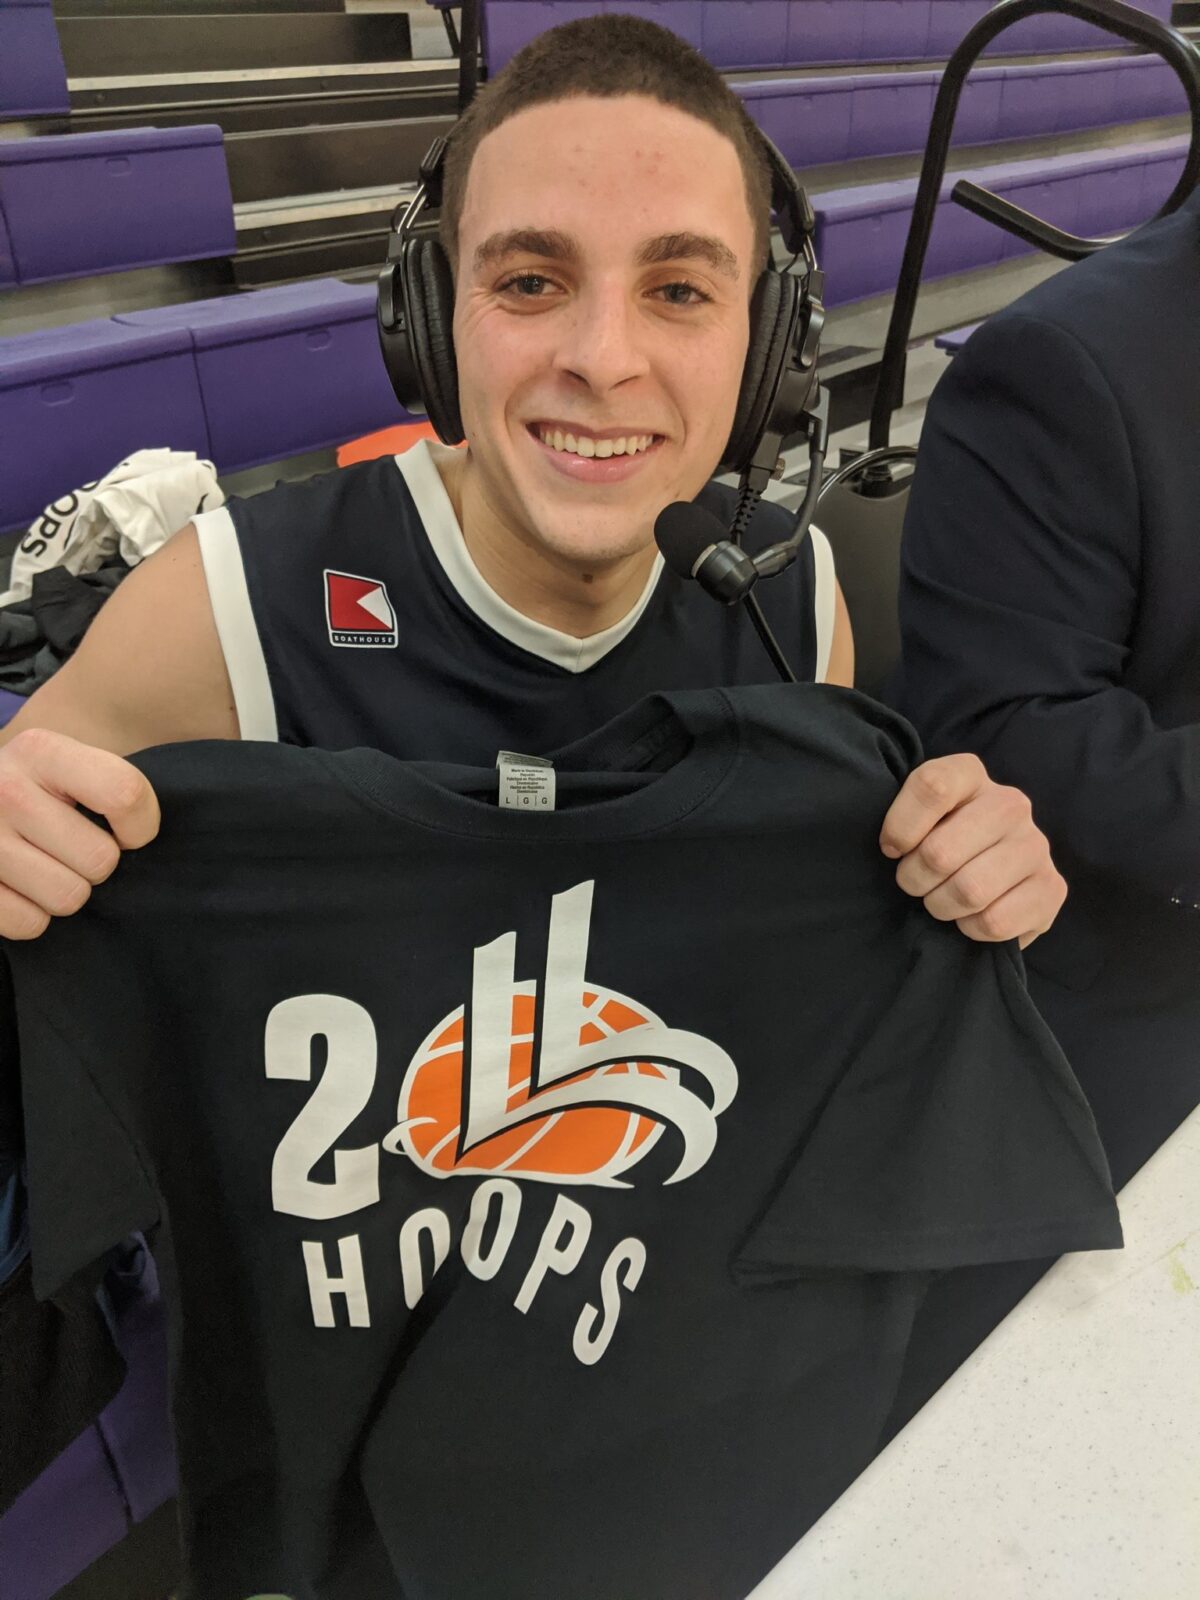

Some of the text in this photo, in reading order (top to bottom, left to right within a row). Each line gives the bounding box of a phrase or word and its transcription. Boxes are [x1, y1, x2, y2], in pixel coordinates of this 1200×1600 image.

[334, 635, 393, 643] BOATHOUSE
[505, 796, 548, 805] L G G
[301, 1178, 647, 1366] HOOPS
